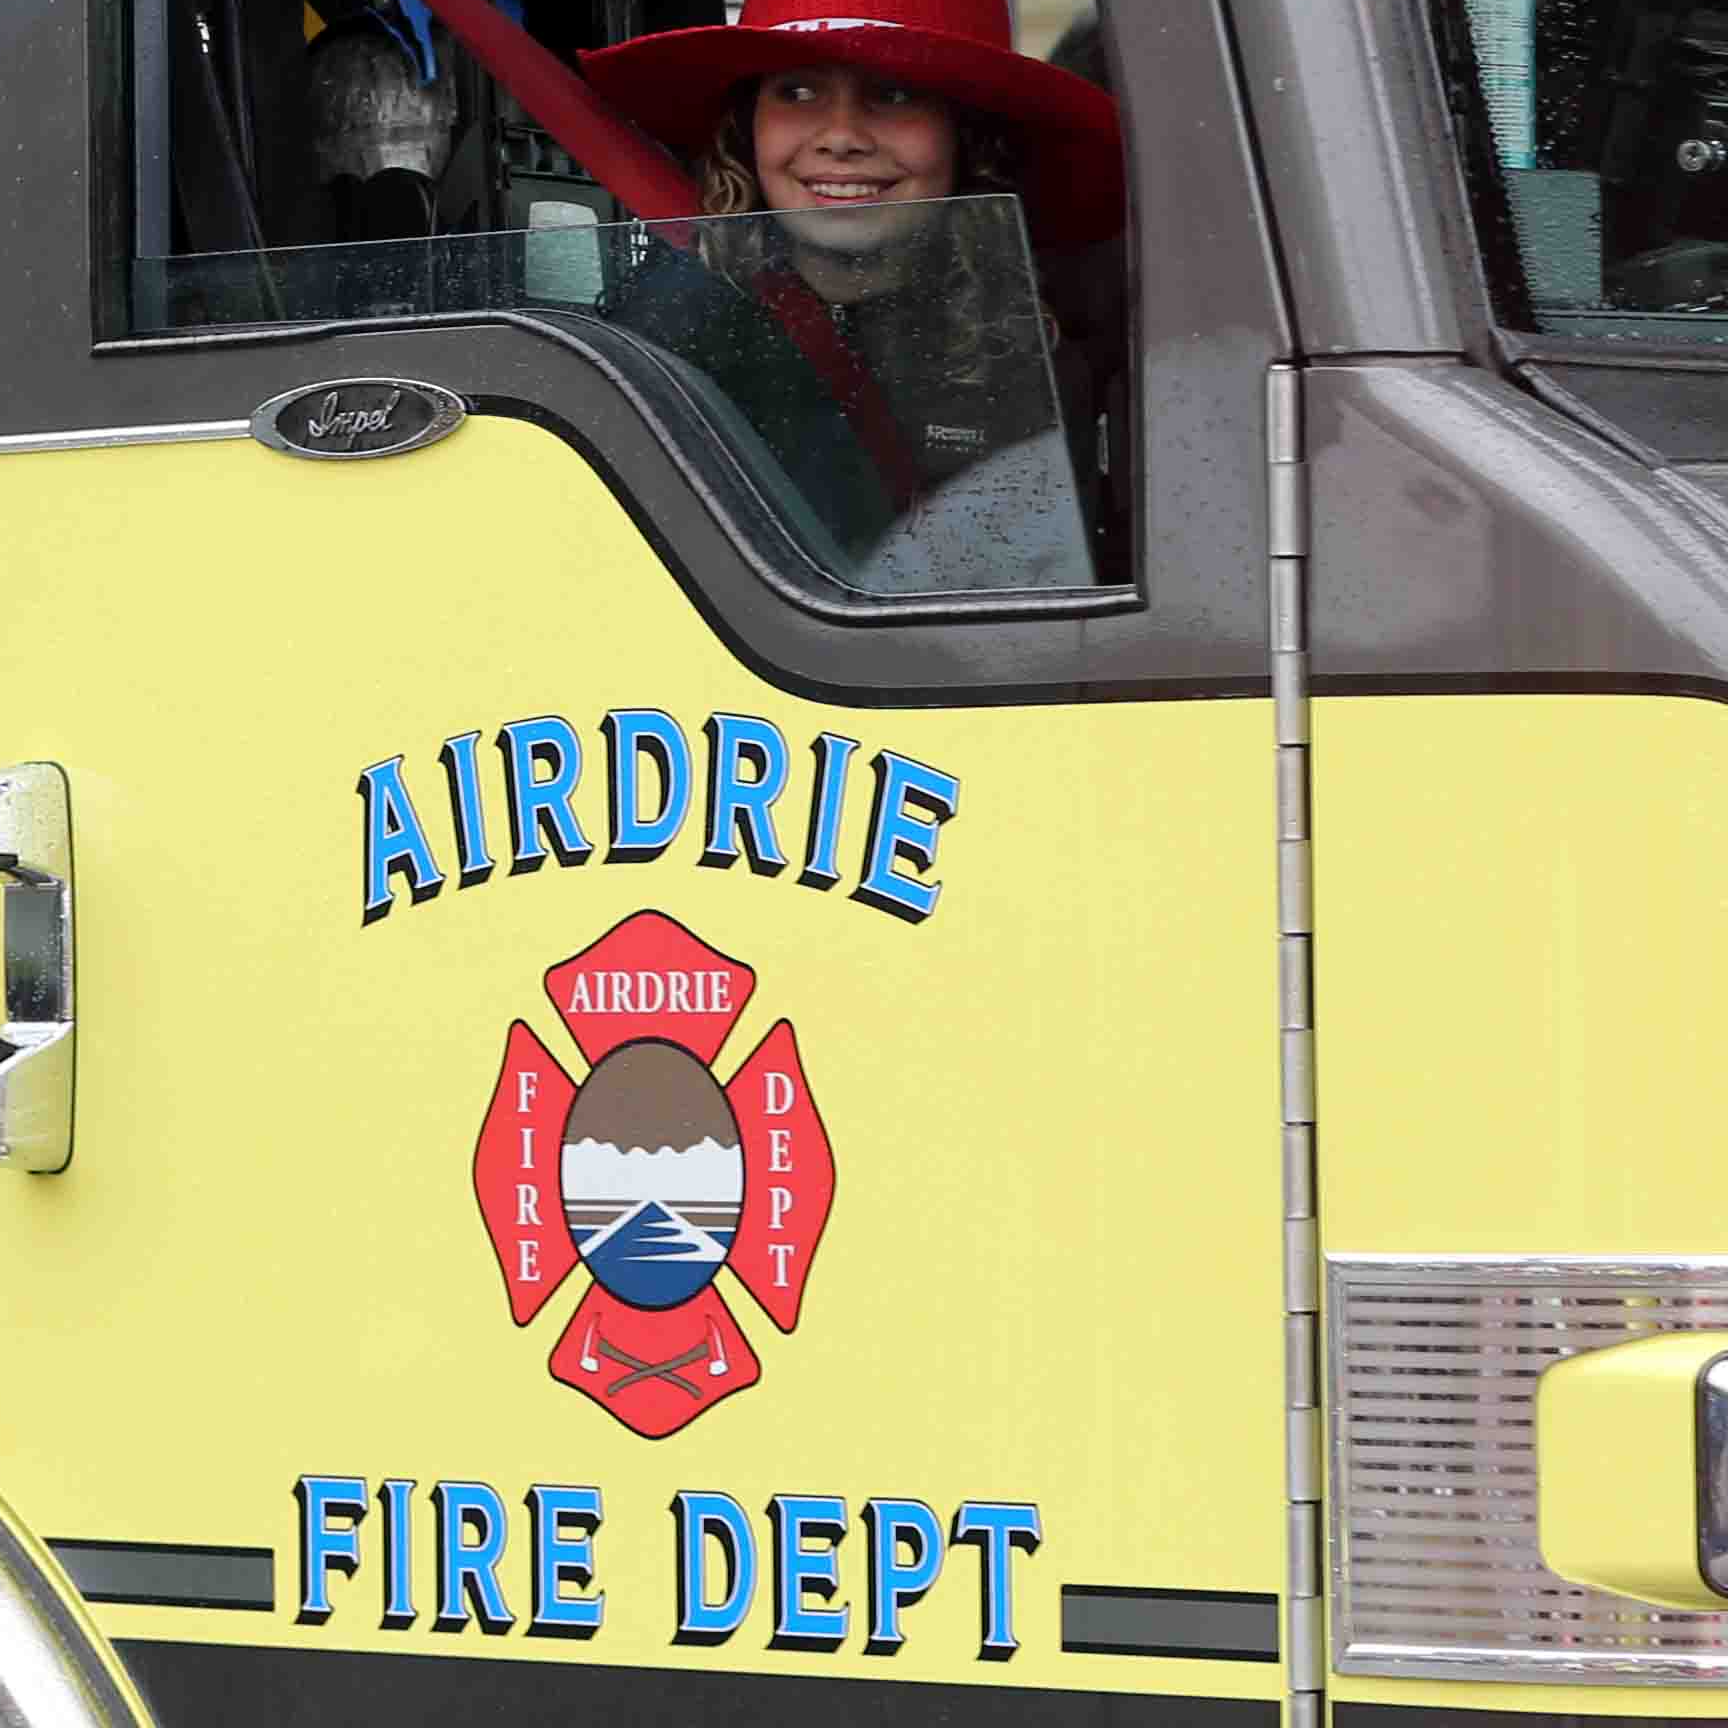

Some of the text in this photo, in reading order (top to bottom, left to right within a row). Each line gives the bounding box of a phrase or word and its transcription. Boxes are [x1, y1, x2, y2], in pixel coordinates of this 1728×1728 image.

[307, 390, 402, 450] Impel
[355, 707, 961, 928] AIRDRIE
[568, 970, 735, 1014] AIRDRIE
[515, 1071, 543, 1282] FIRE
[763, 1071, 796, 1288] DEPT
[292, 1475, 1044, 1663] FIRE DEPT
